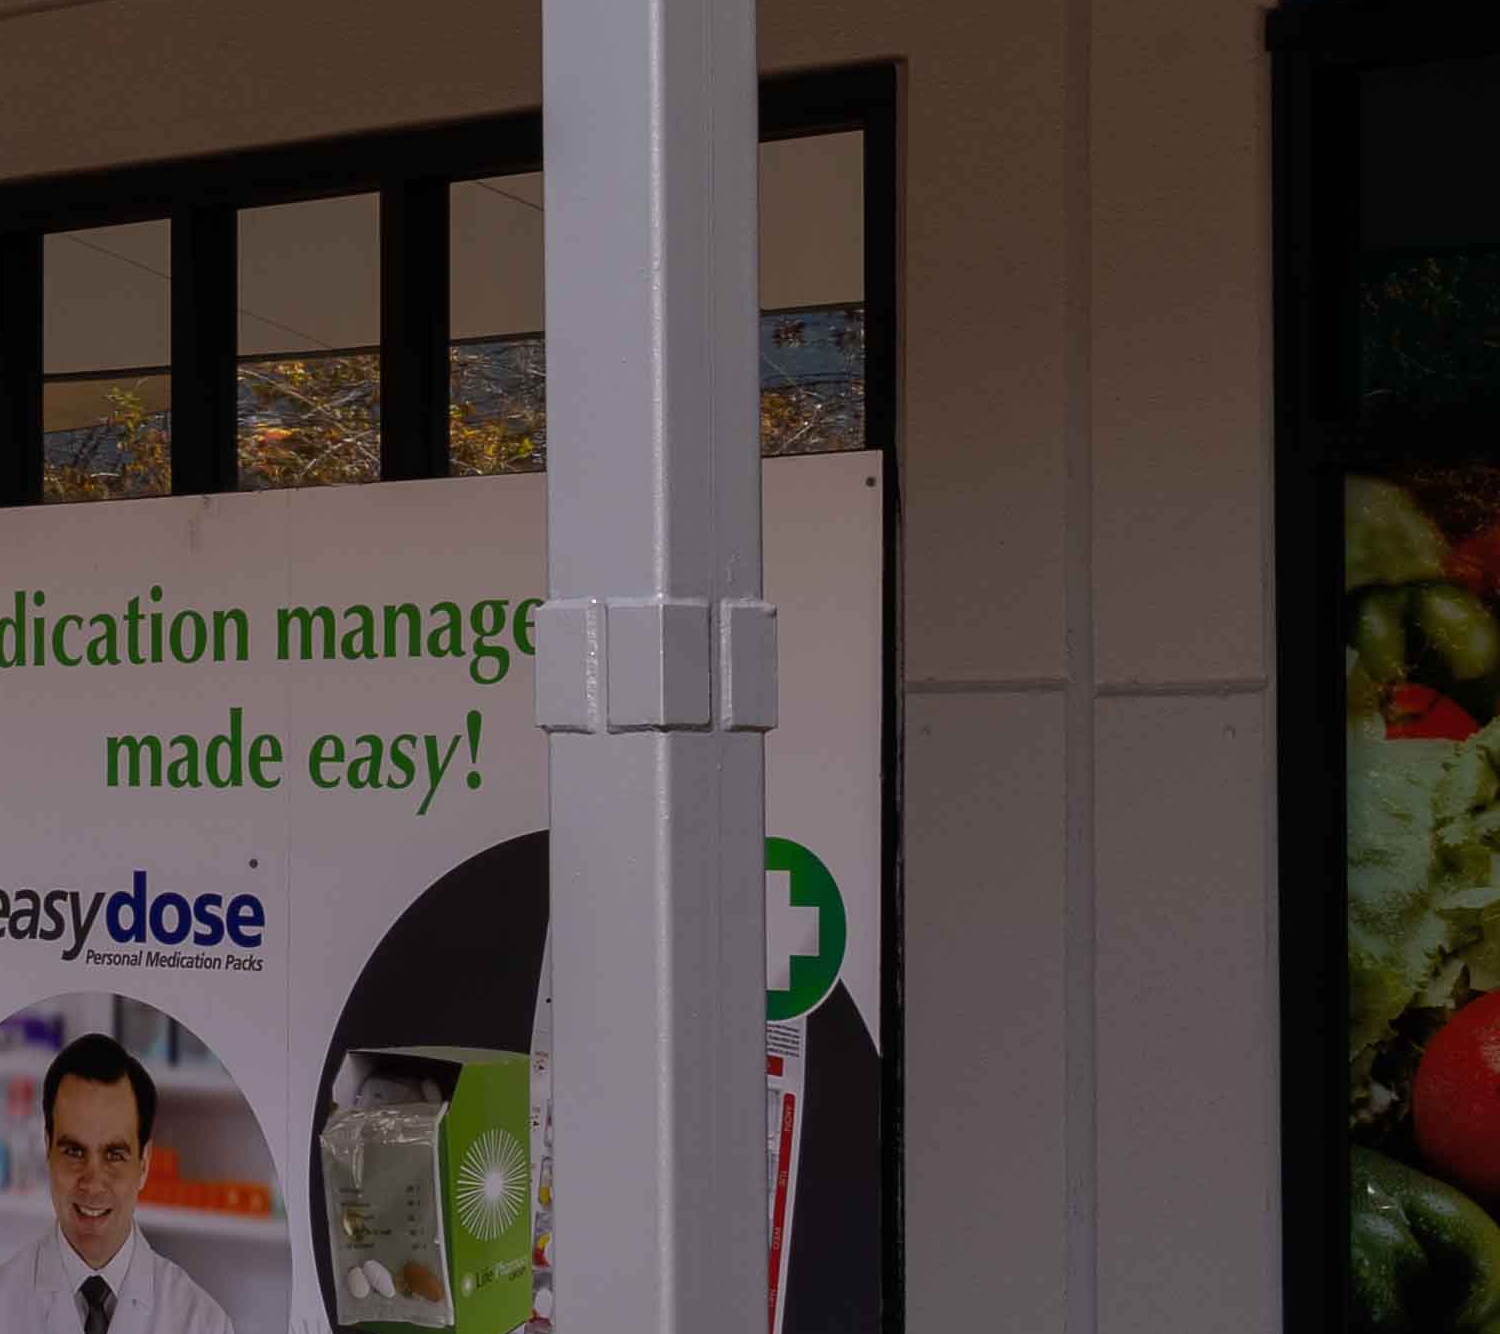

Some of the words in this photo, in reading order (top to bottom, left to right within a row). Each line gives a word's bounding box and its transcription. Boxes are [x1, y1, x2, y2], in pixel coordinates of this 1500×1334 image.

[277, 597, 538, 683] manage
[105, 708, 283, 789] made
[308, 709, 483, 816] easy!
[85, 950, 143, 968] Personal
[145, 952, 222, 971] Medication
[223, 954, 263, 973] Packs
